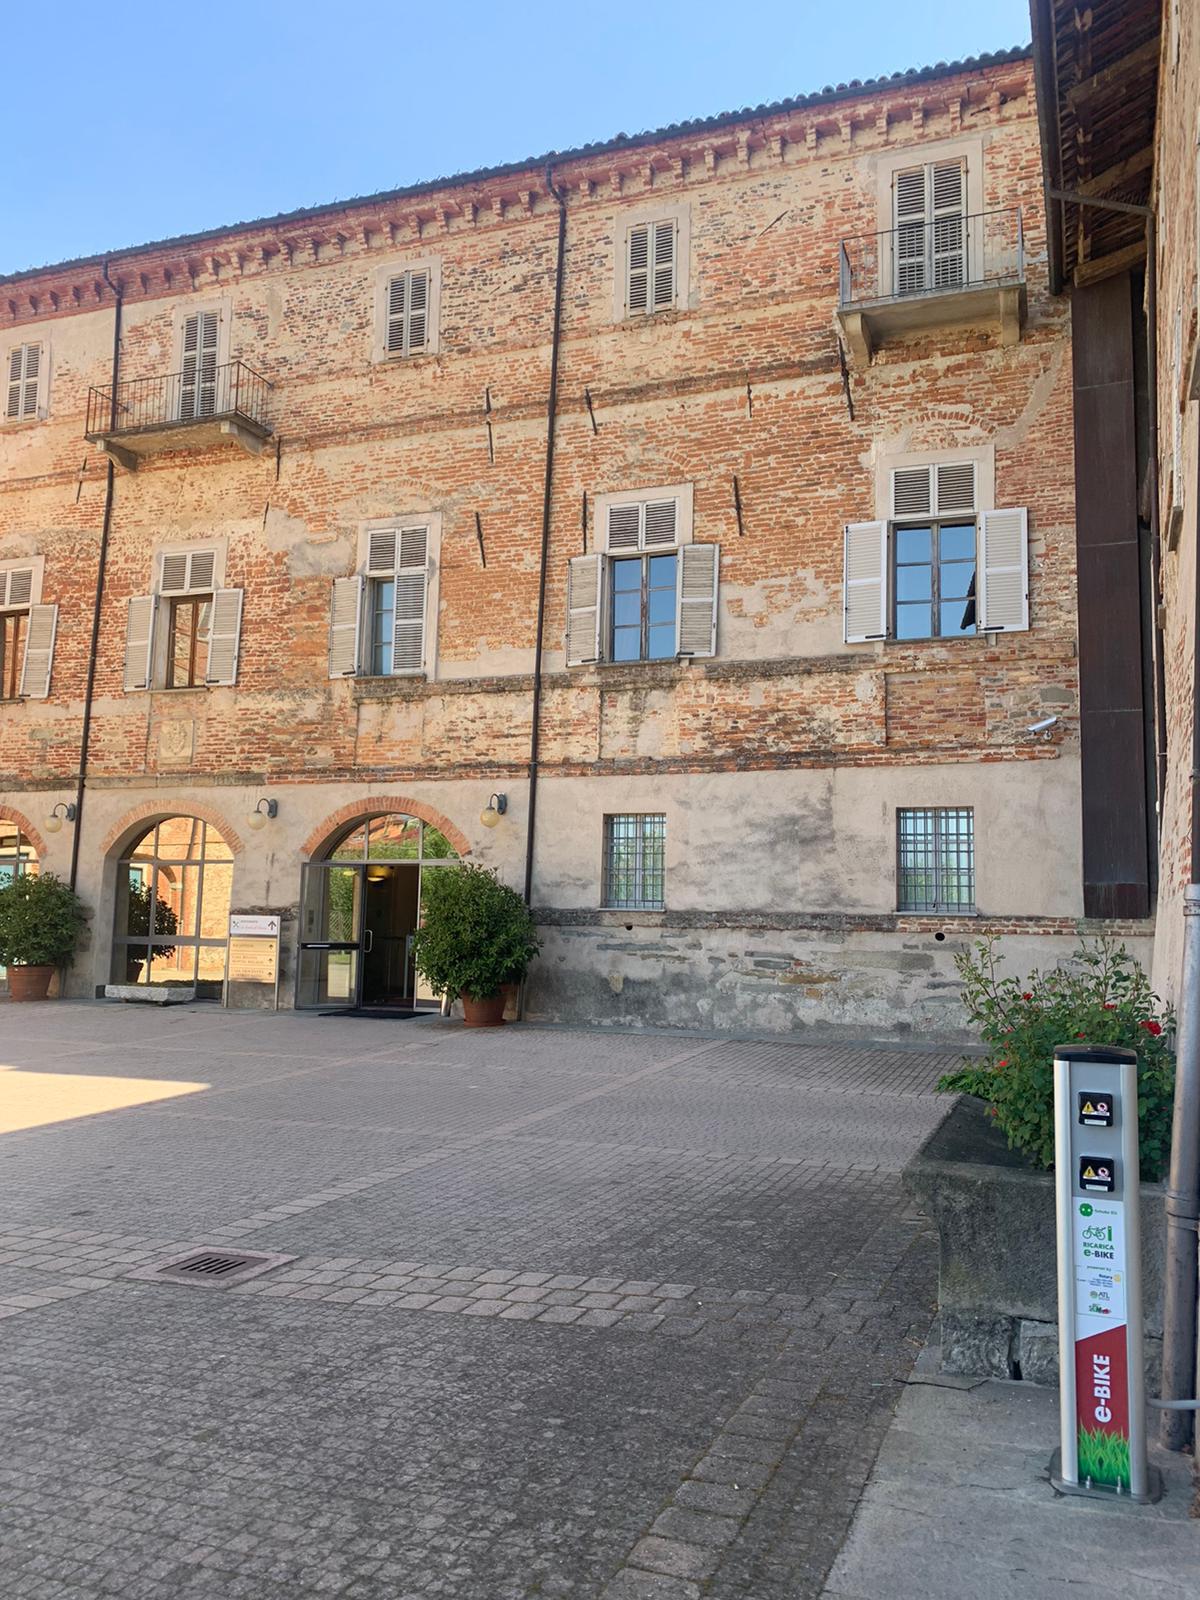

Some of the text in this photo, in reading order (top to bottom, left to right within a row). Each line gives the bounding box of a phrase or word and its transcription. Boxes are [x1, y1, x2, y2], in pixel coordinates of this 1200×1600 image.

[1083, 1242, 1114, 1250] RICARICA
[1083, 1249, 1114, 1259] e-BIKE
[1093, 1354, 1112, 1423] e-BIKE
